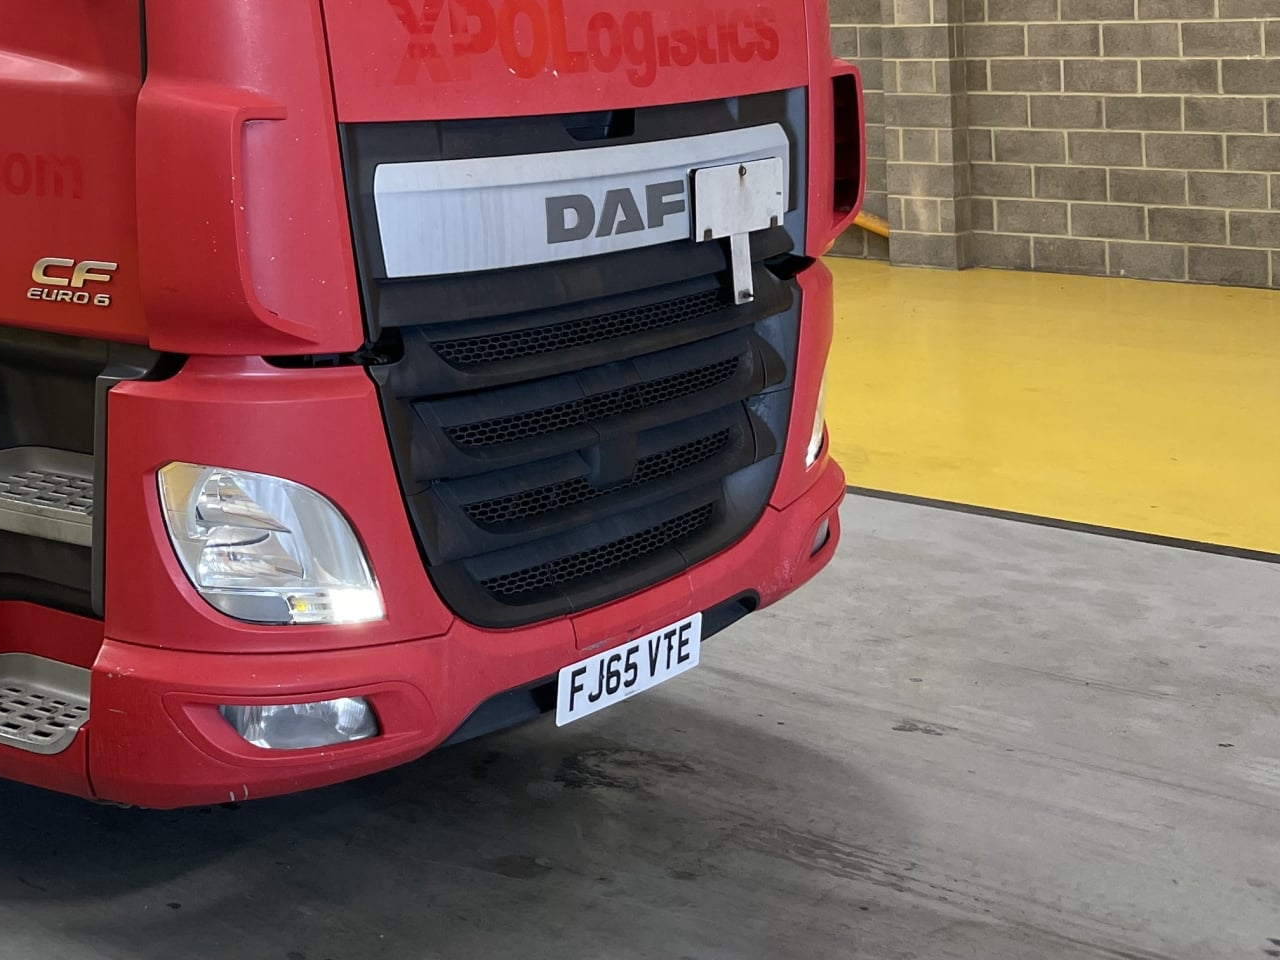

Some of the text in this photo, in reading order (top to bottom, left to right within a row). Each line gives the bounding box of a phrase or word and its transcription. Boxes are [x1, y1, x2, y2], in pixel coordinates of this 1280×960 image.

[545, 179, 686, 244] DAF
[31, 257, 118, 288] CF
[27, 287, 110, 307] EURO 6
[569, 621, 692, 713] FJ65 VTE
